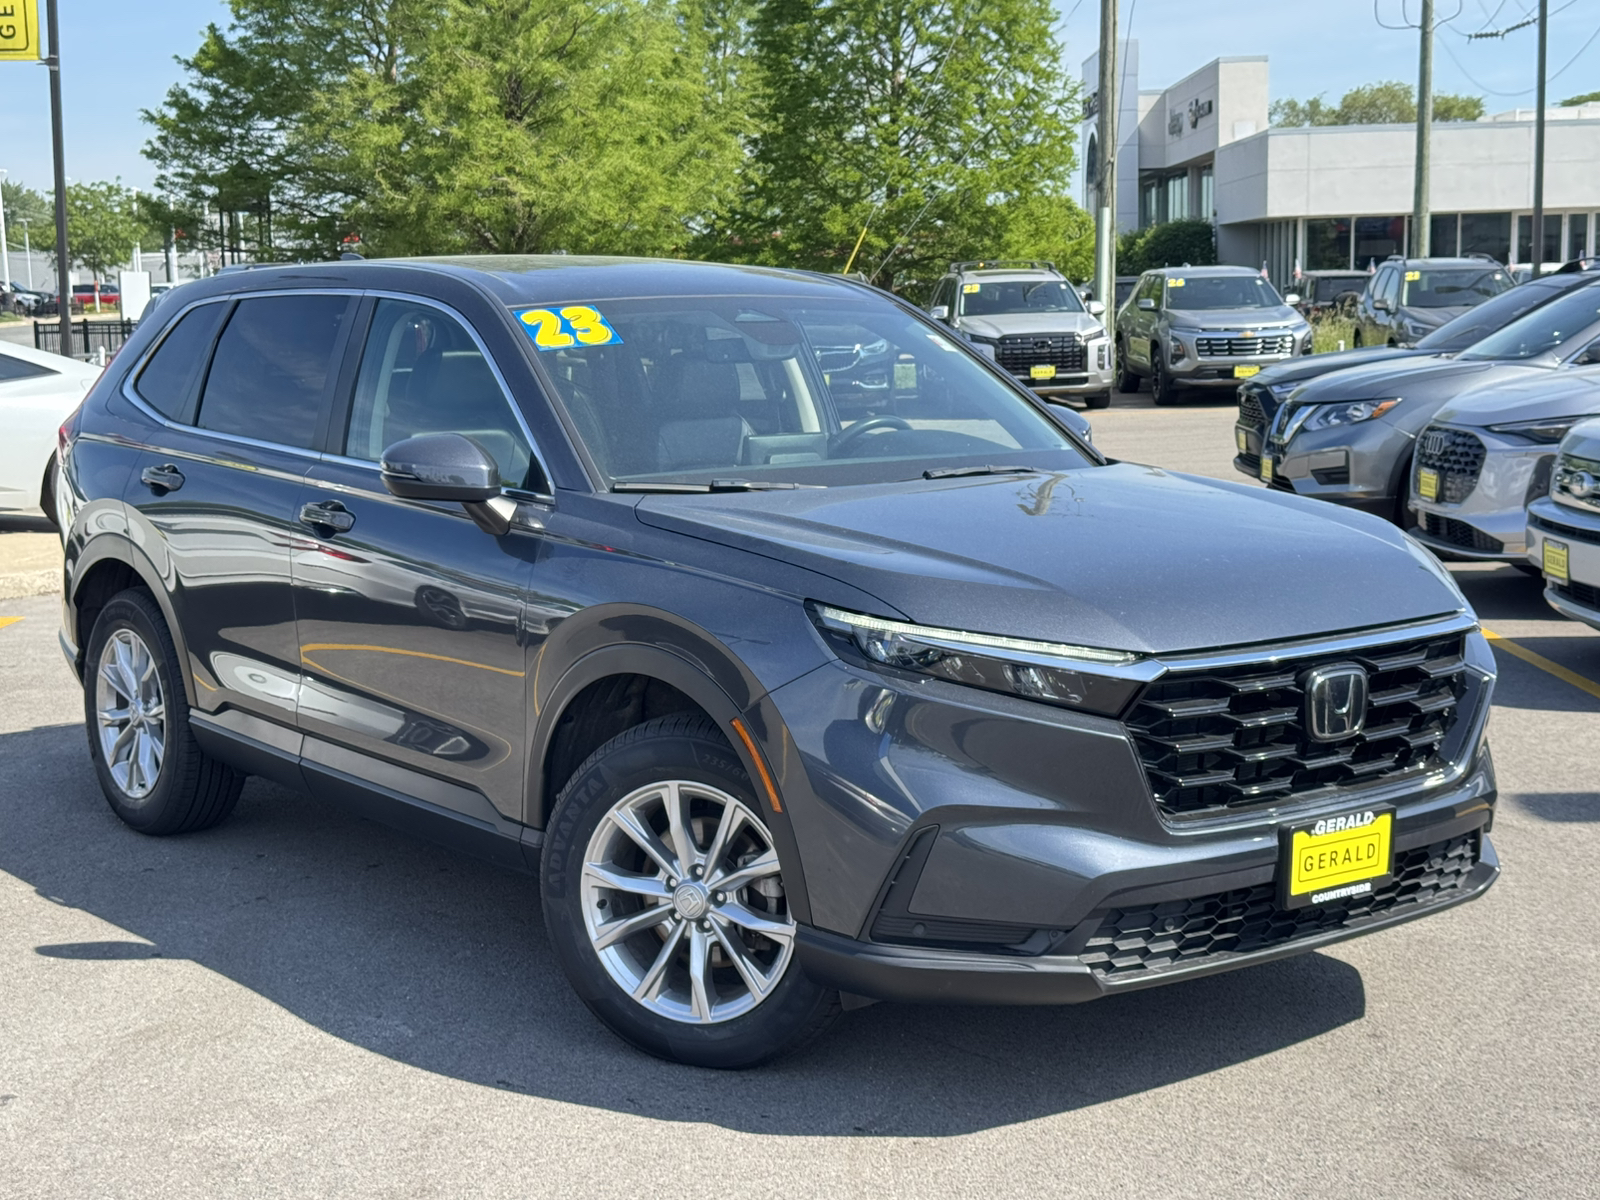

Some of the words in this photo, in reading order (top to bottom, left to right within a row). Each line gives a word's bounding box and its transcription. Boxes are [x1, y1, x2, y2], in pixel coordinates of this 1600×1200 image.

[520, 306, 612, 346] 23
[548, 777, 603, 890] ADVANTA
[1315, 811, 1375, 836] GERALD
[1304, 843, 1376, 872] GERALD
[1312, 882, 1371, 904] COUNTRYSIDE
